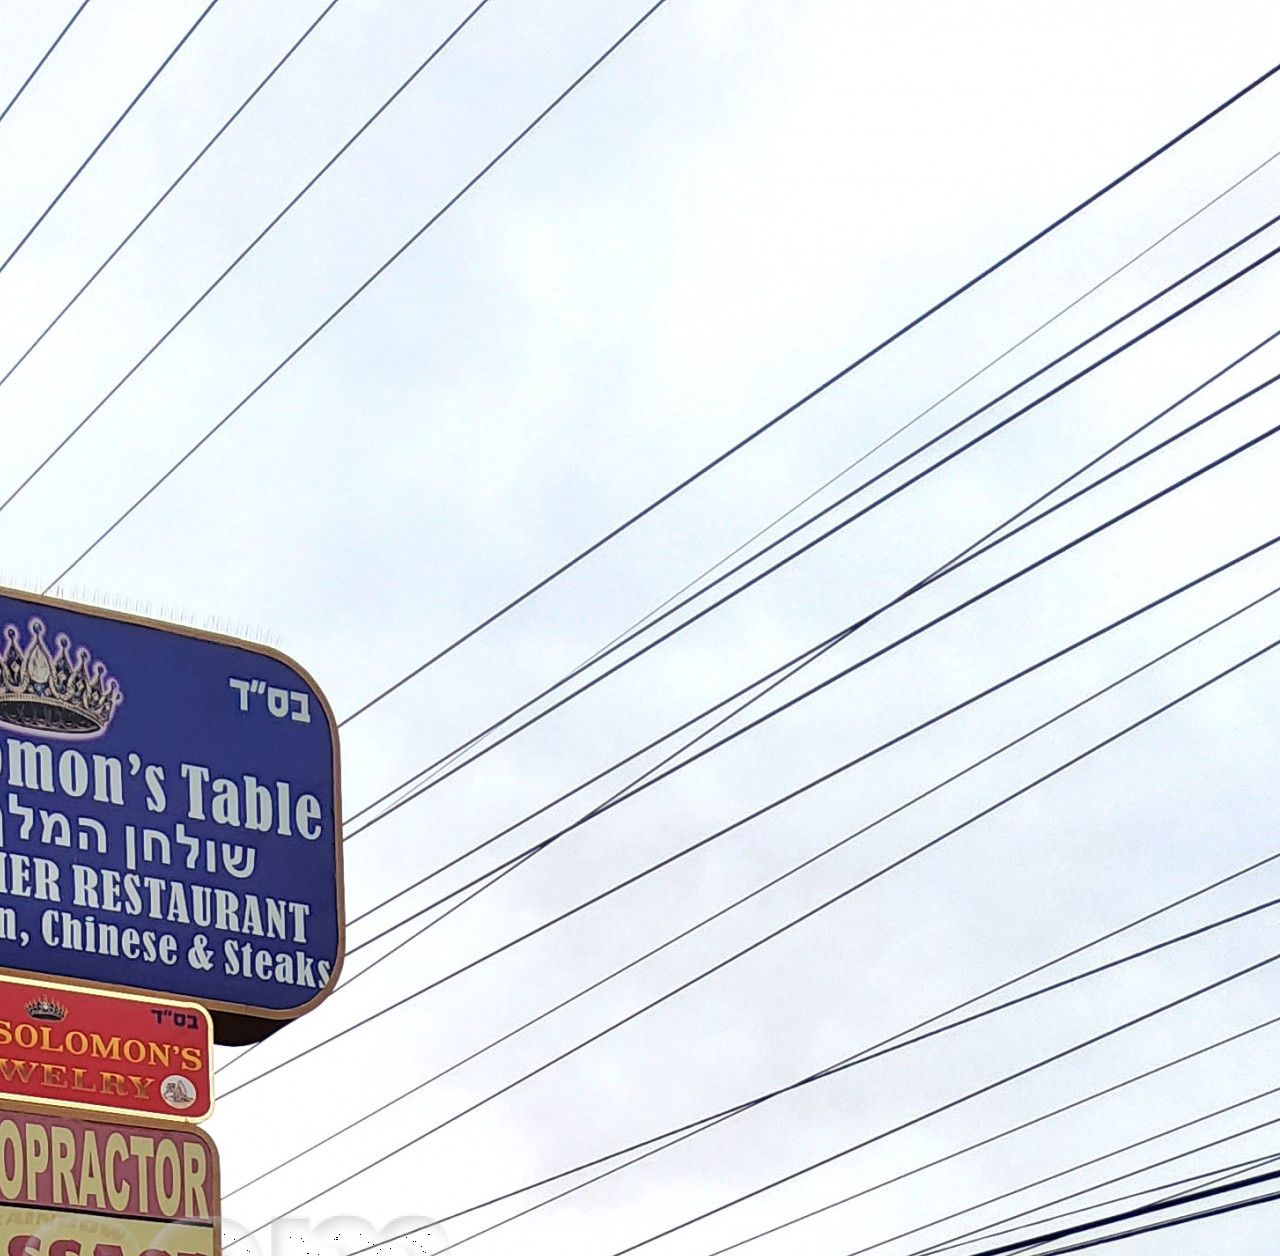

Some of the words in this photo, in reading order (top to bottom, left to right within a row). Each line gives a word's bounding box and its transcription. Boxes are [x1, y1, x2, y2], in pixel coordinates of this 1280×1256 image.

[180, 764, 322, 840] Table
[125, 824, 255, 878] שולחן
[71, 864, 311, 944] RESTAURANT
[42, 913, 177, 965] Chinese
[188, 934, 214, 972] &
[223, 942, 331, 989] Steaks
